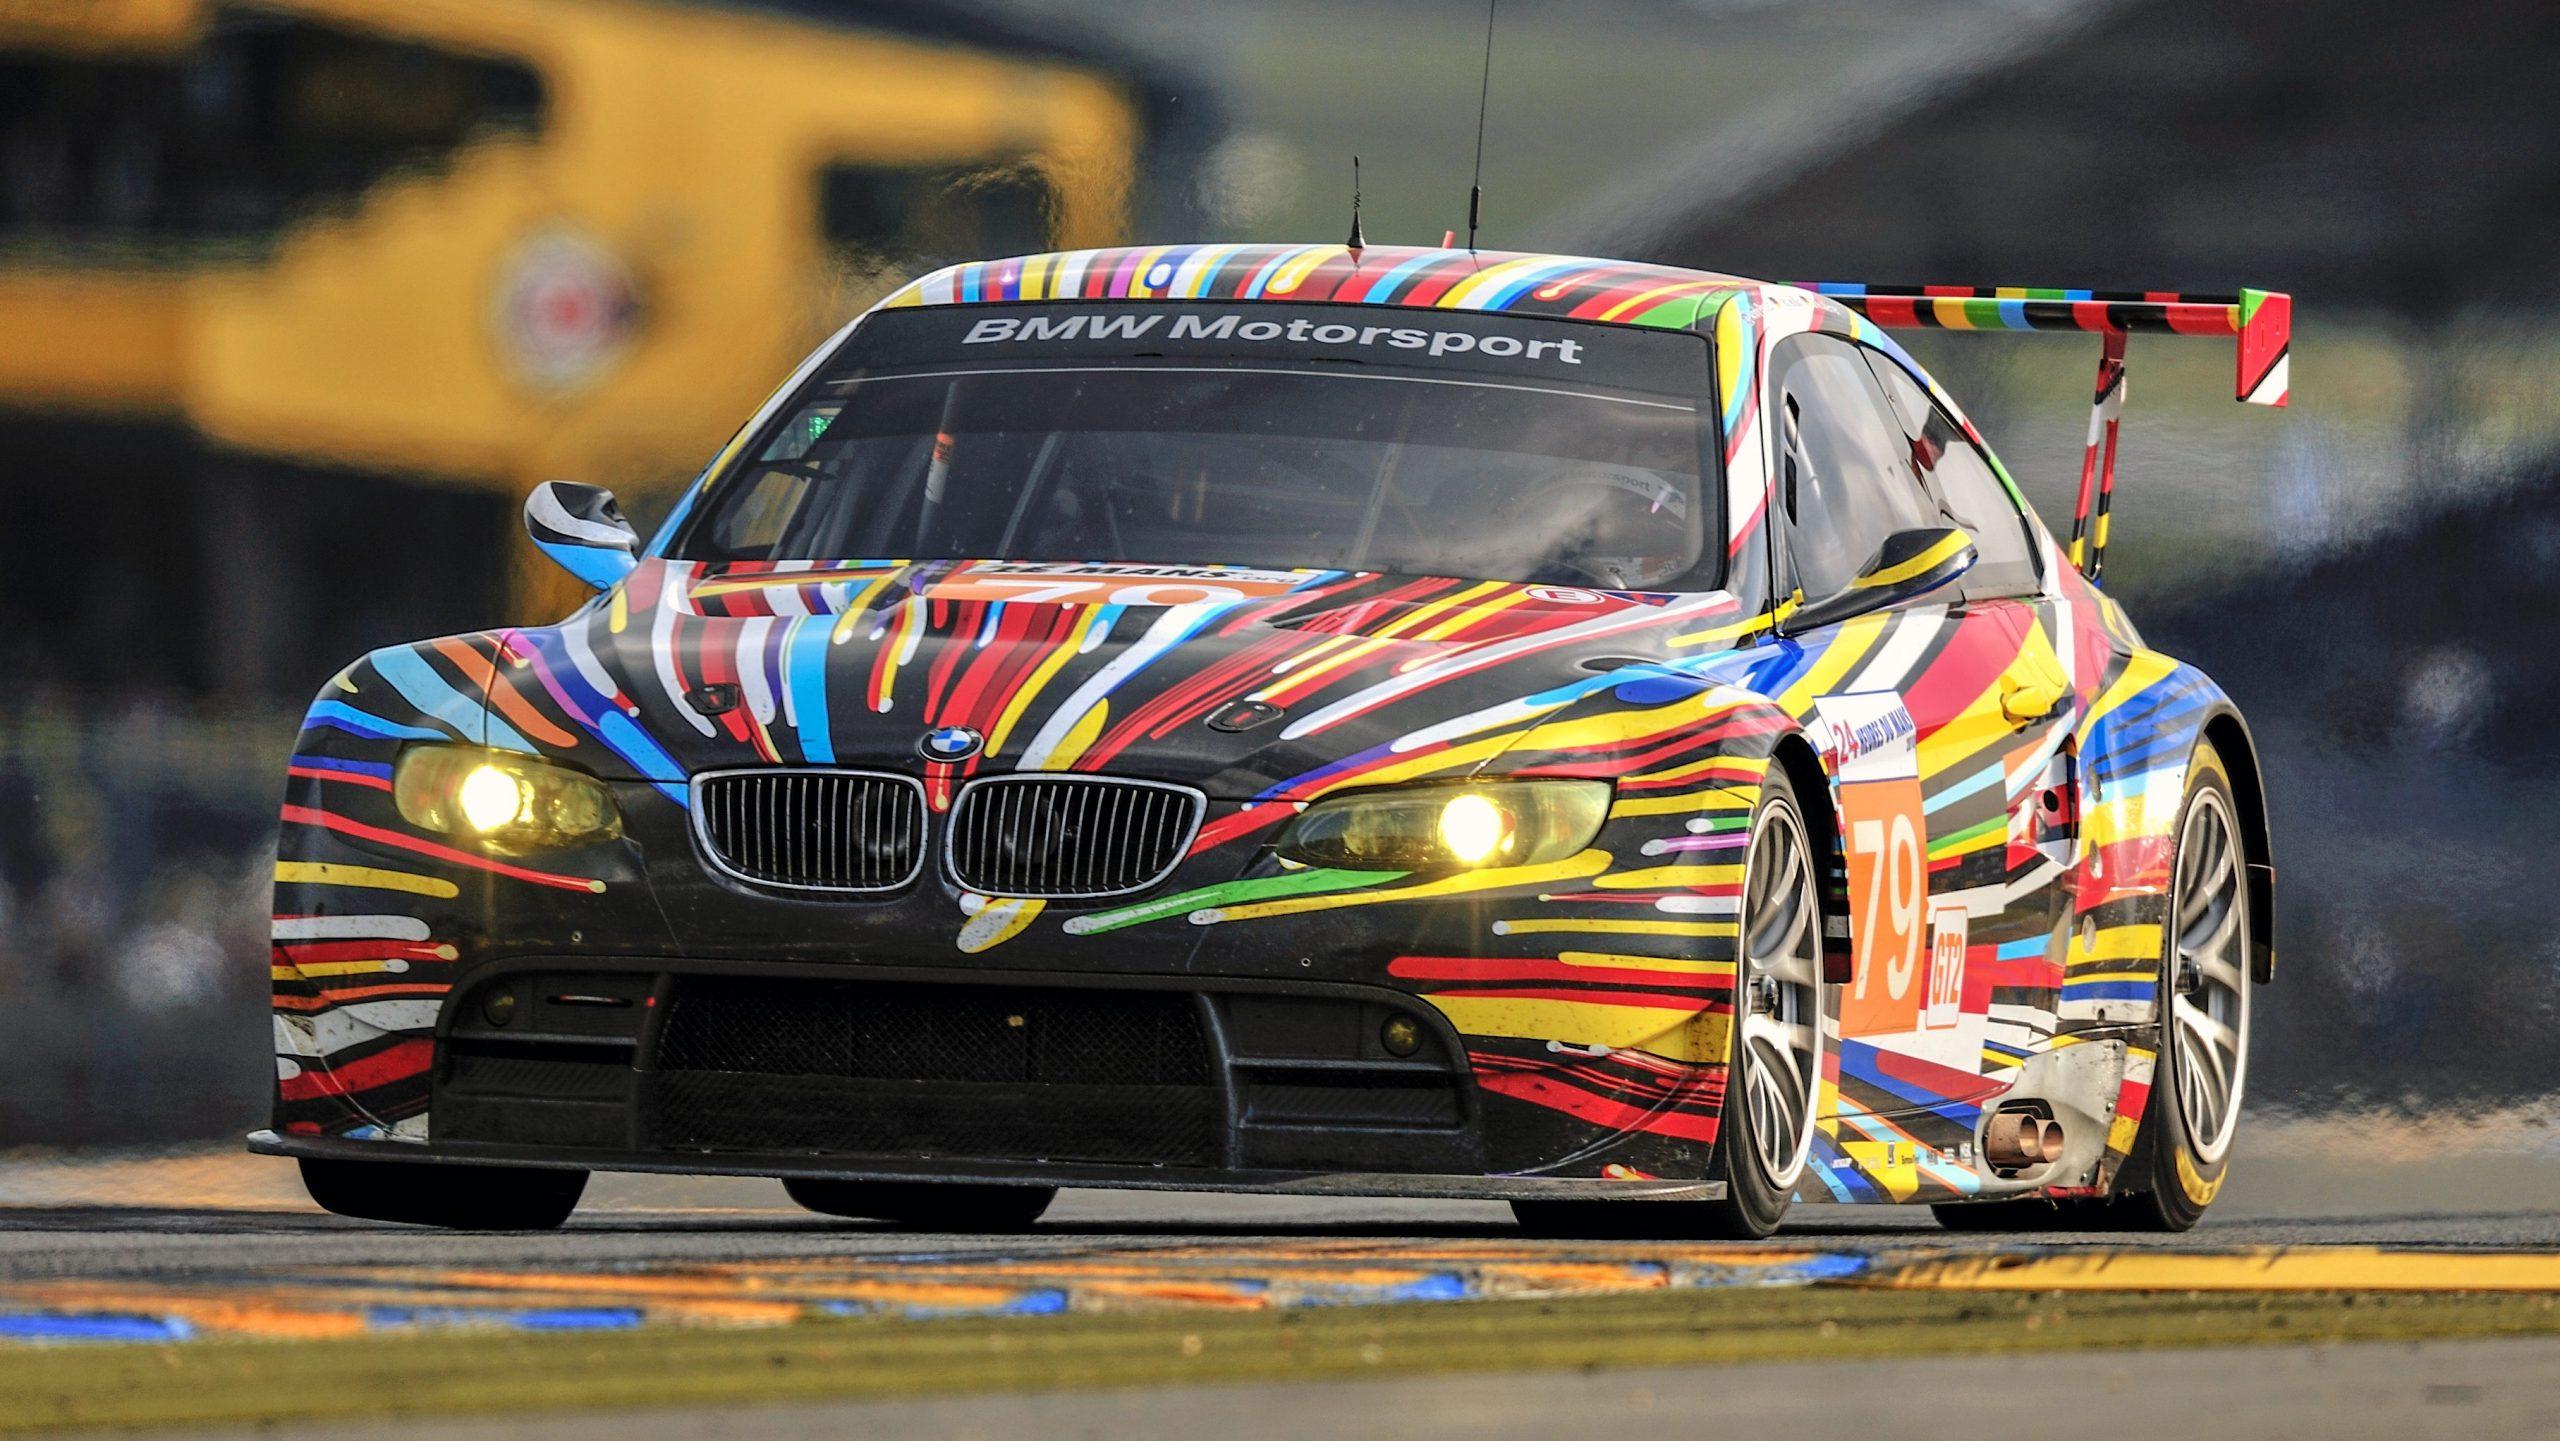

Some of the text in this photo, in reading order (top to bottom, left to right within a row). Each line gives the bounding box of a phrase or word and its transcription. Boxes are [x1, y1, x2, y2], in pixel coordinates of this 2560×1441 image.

[962, 315, 1584, 364] BMW Motorsport
[1832, 719, 1859, 766] 24
[1855, 720, 1885, 755] HEURES
[1878, 714, 1895, 743] DU
[1888, 705, 1914, 738] MANS
[1852, 813, 1922, 1001] 79
[1932, 931, 1963, 1006] GT2
